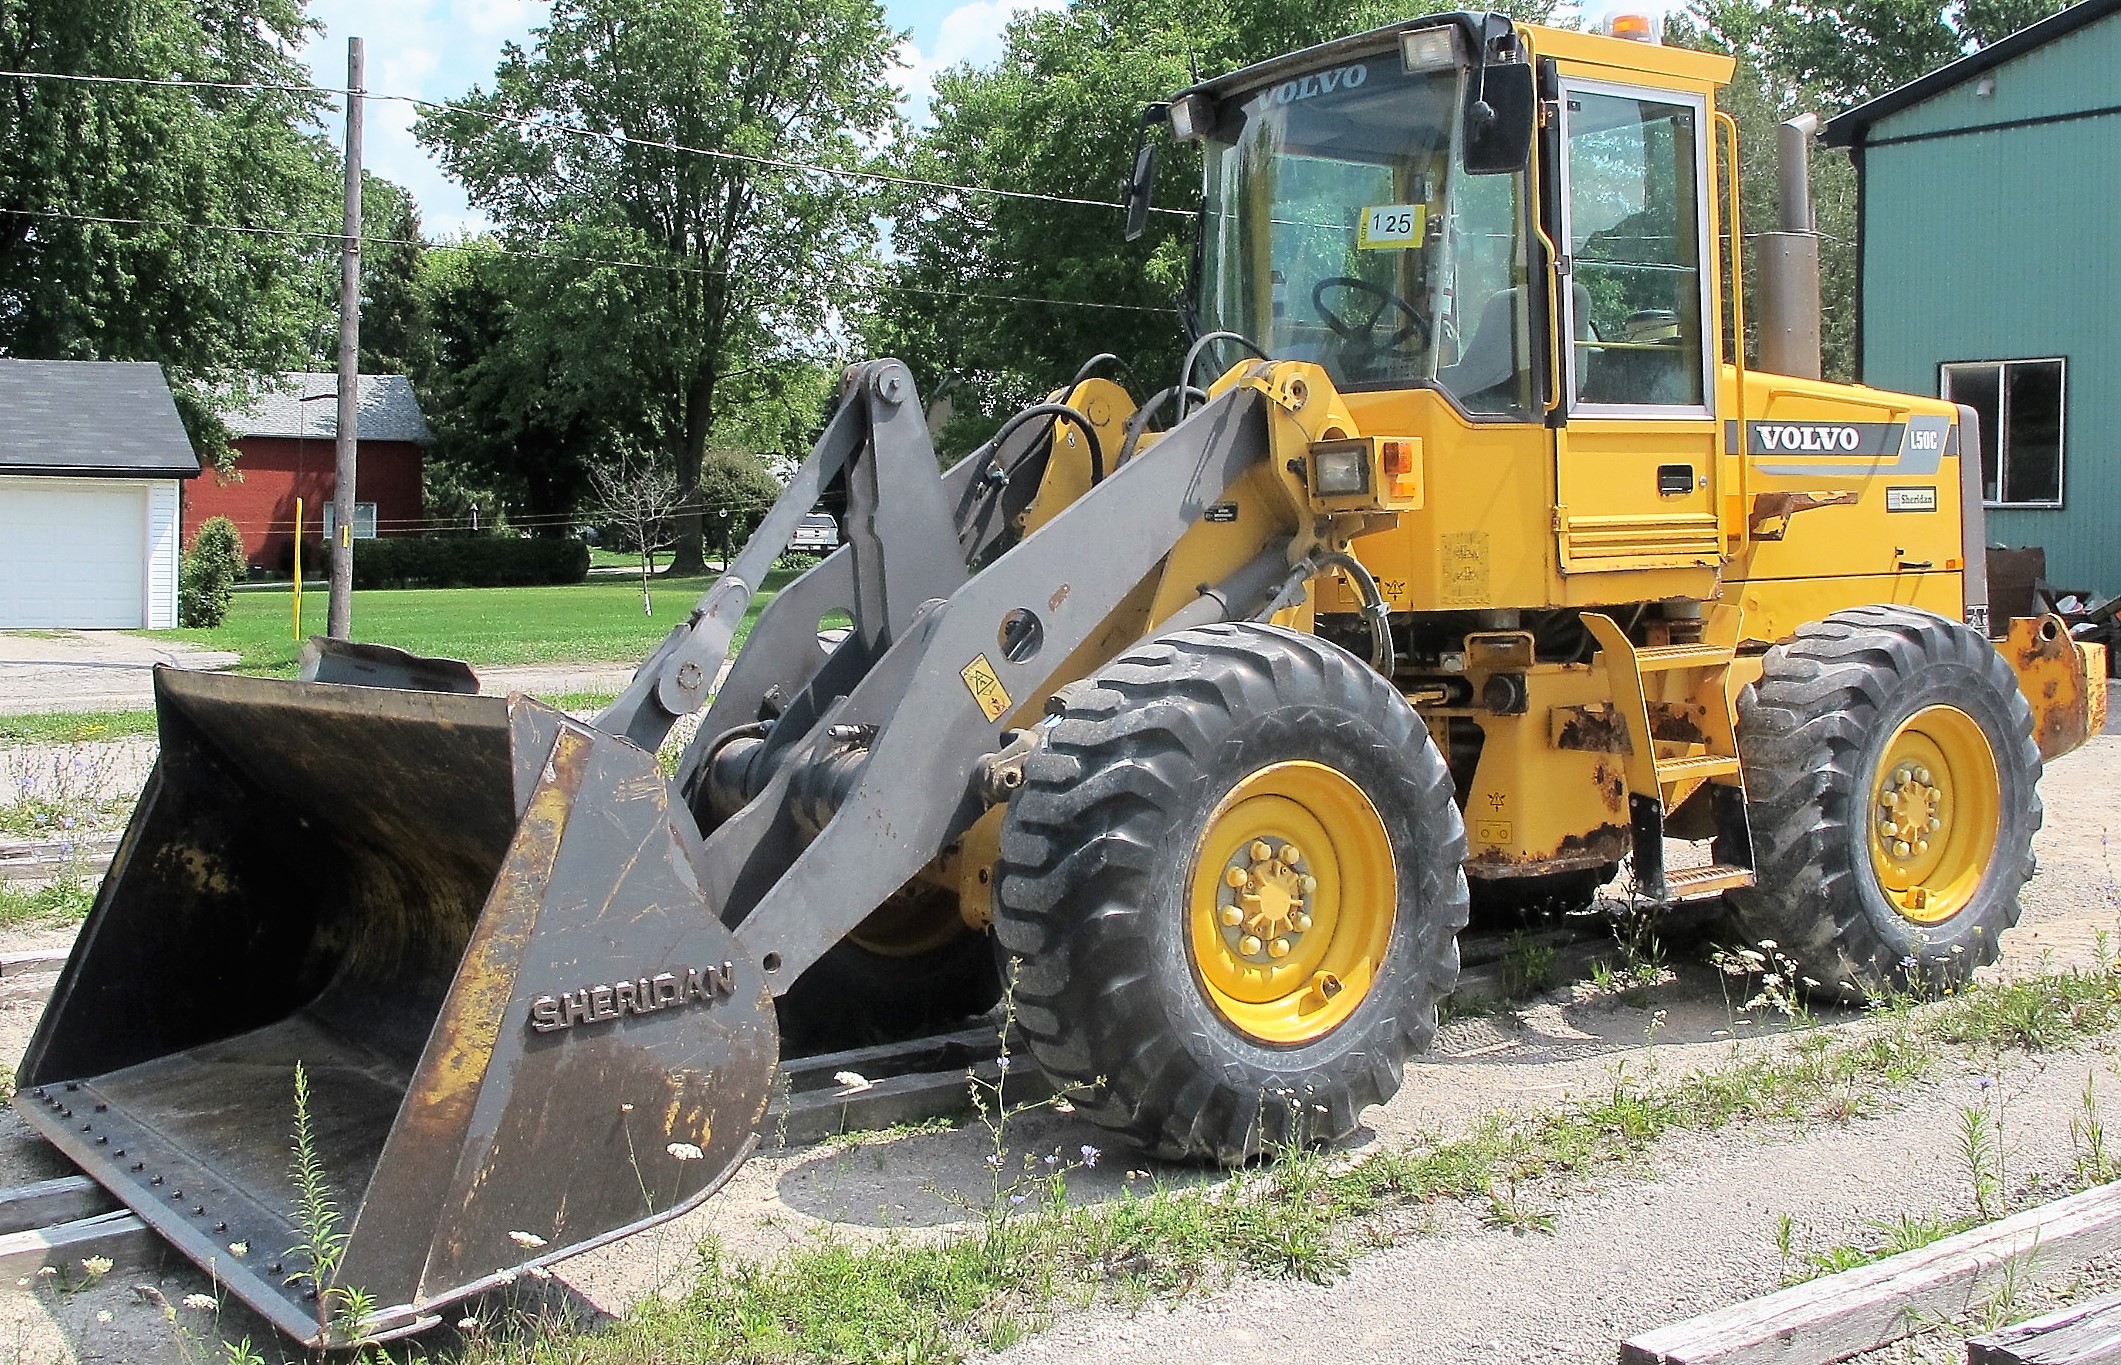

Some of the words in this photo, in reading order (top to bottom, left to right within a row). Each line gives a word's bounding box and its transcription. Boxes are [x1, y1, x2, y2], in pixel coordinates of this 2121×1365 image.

[1257, 64, 1367, 111] VOLVO
[1373, 213, 1411, 233] 125
[1756, 426, 1860, 450] VOLVO
[1910, 430, 1938, 449] L50C
[1901, 494, 1932, 505] Sheridan
[532, 960, 735, 1033] SHERIDAN
